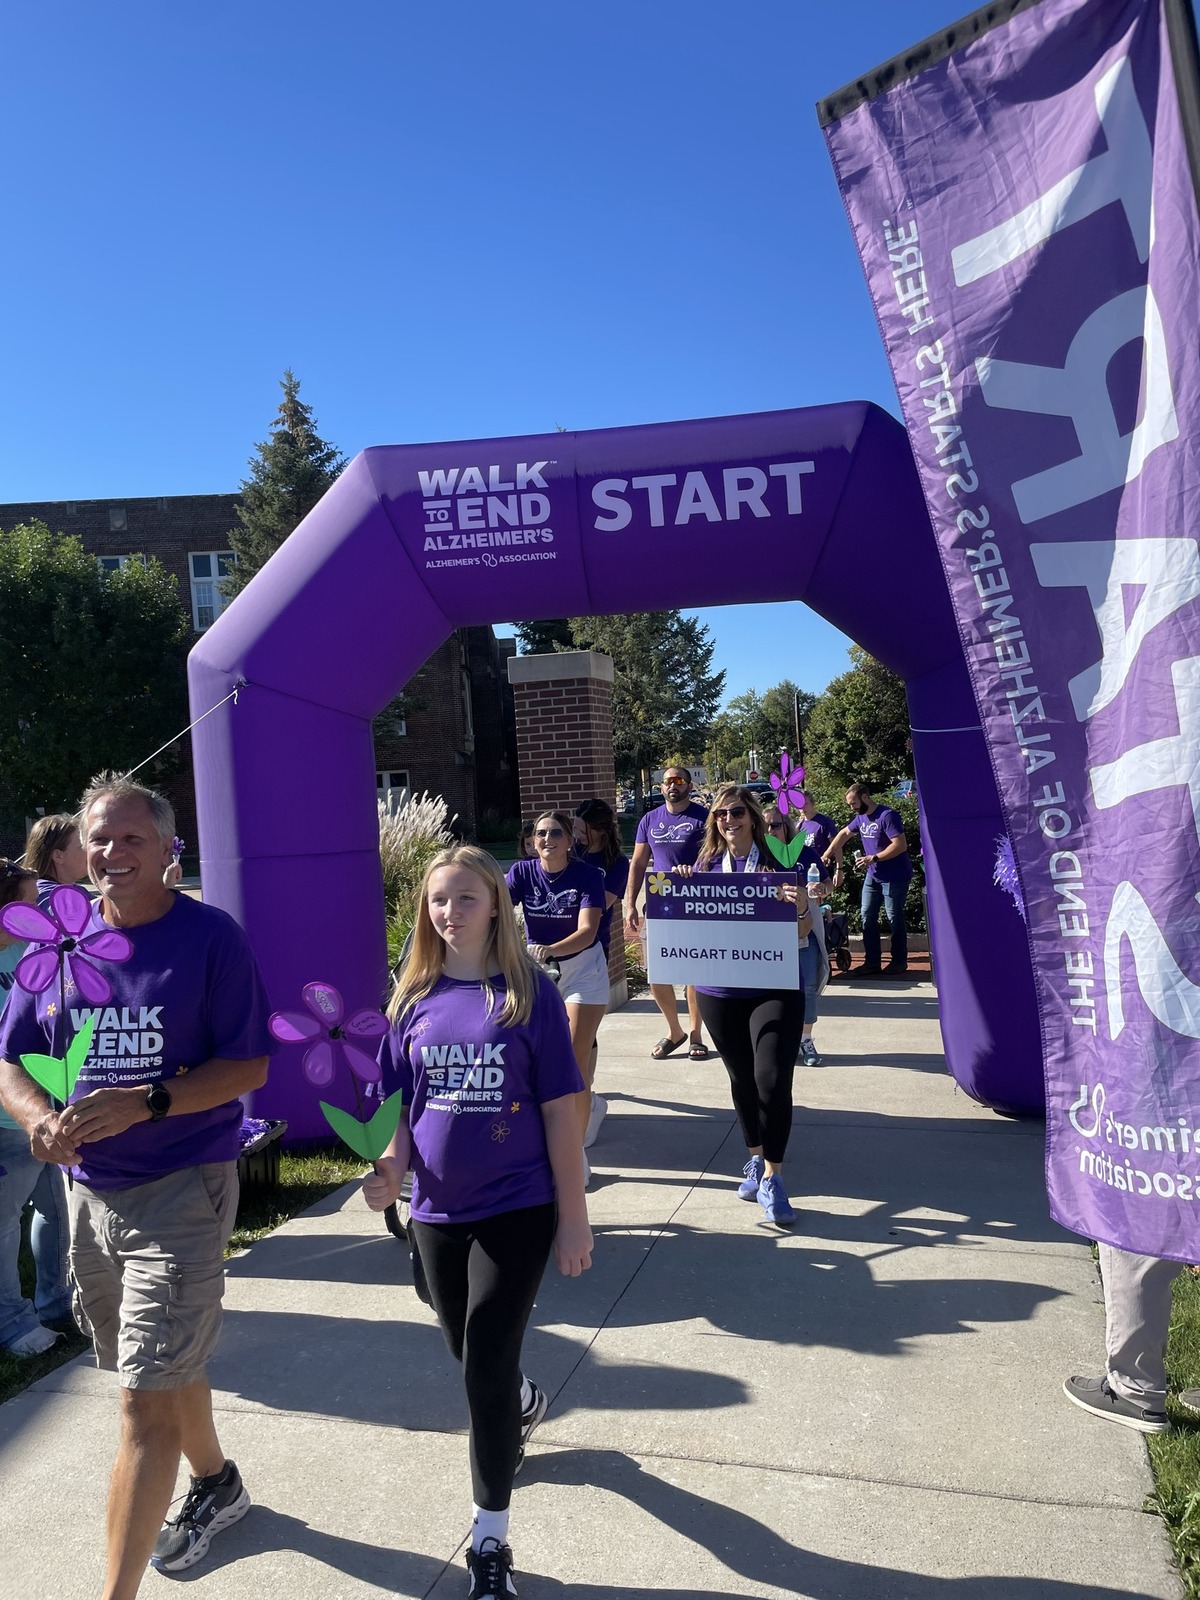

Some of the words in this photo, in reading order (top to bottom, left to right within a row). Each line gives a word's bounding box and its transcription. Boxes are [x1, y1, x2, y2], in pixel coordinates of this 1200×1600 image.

[418, 461, 549, 497] WALK
[591, 460, 815, 532] START
[426, 509, 449, 522] TO
[457, 493, 551, 530] END
[423, 528, 554, 552] ALZHEIMER'S
[425, 557, 481, 569] ALZHEIMER'S
[498, 552, 557, 564] ASSOCIATION
[662, 885, 738, 897] PLANTING
[743, 886, 778, 898] OUR
[685, 902, 755, 915] PROMISE
[660, 948, 727, 960] BANGART
[732, 950, 784, 961] BUNCH
[70, 1006, 164, 1031] WALK
[98, 1032, 164, 1055] END
[81, 1056, 163, 1069] ZHEIMER'S
[421, 1043, 507, 1067] WALK
[447, 1067, 505, 1089] END
[426, 1087, 503, 1102] ALZHEIMER'S
